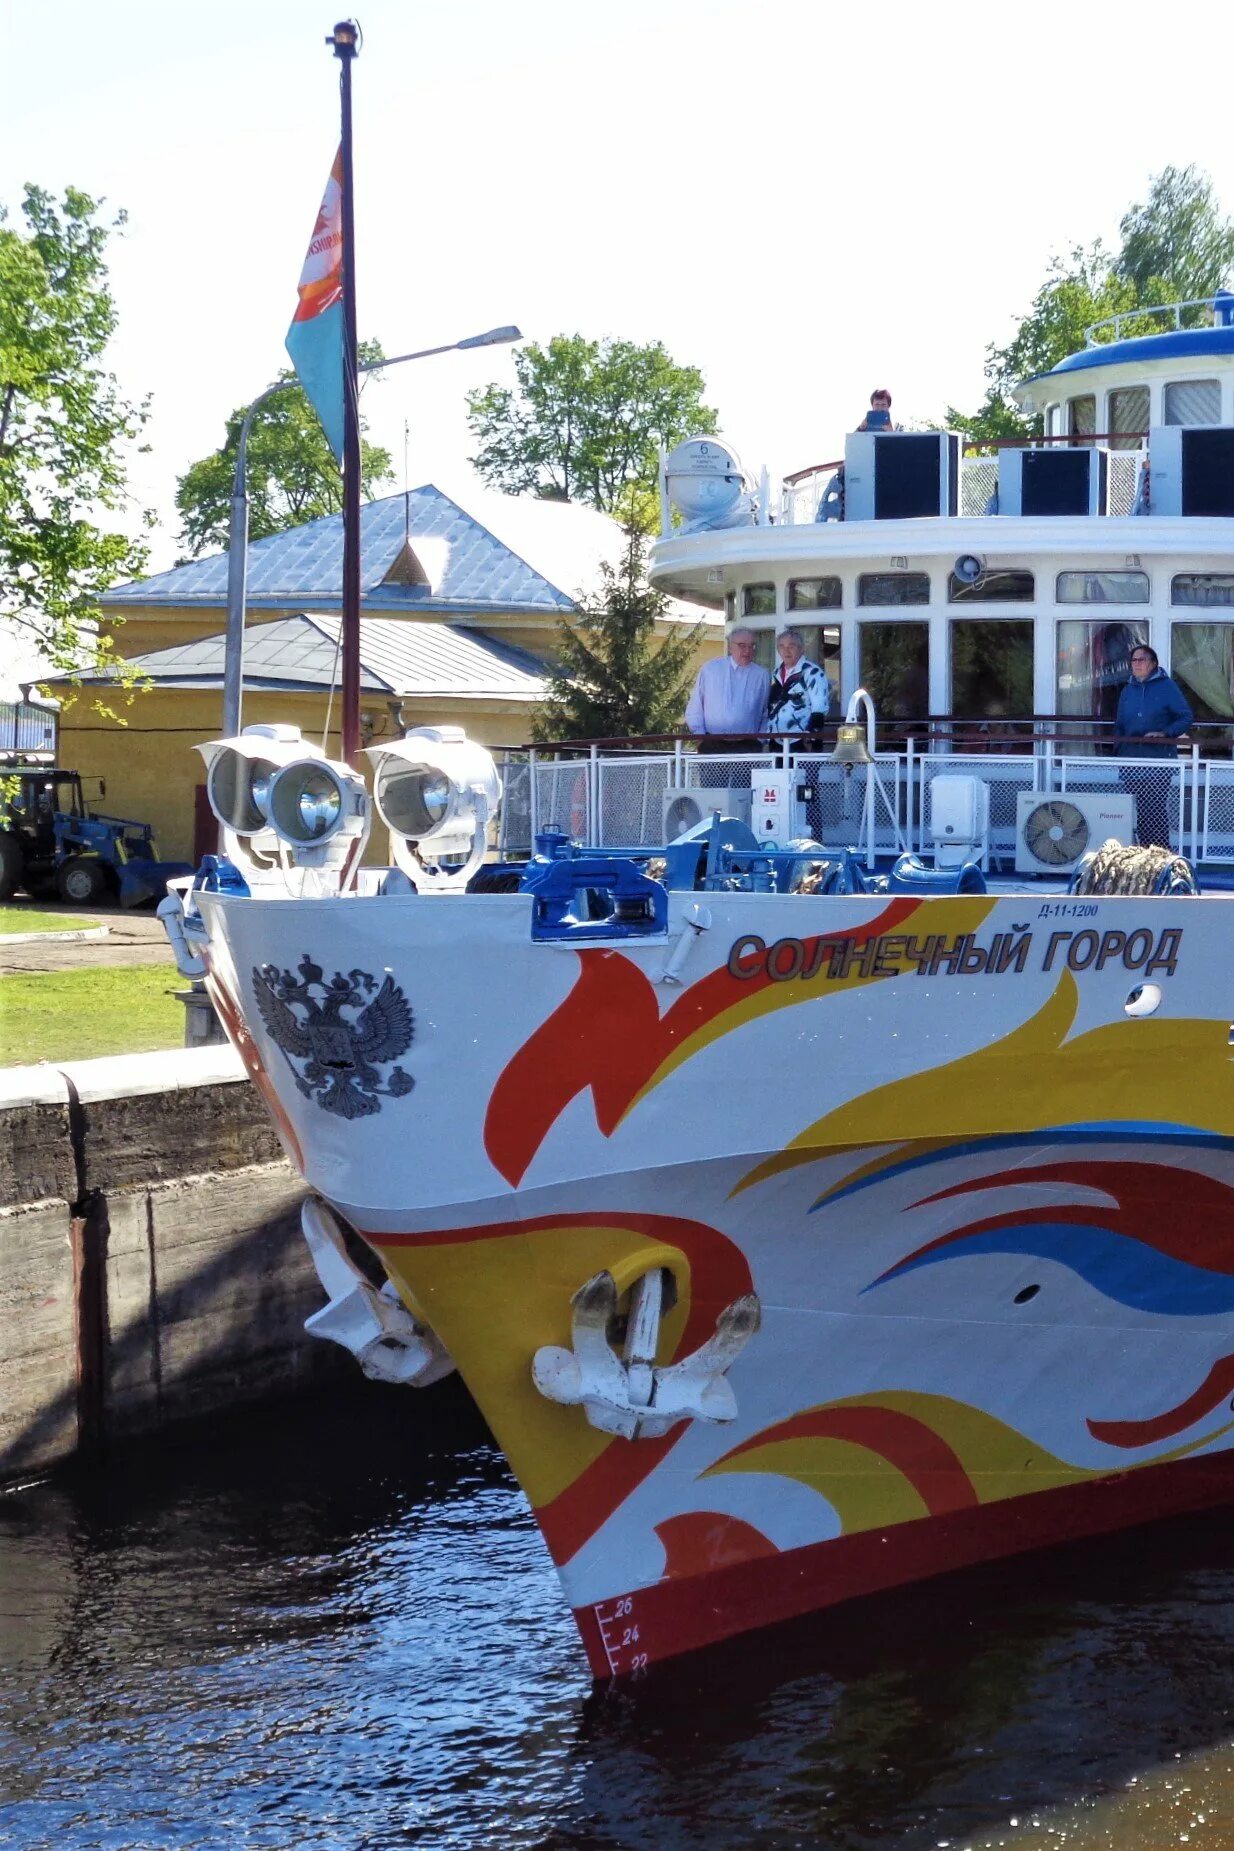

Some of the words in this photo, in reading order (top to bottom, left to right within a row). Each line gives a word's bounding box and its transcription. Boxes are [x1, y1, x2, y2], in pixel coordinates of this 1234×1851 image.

[700, 442, 709, 455] 6
[1037, 904, 1099, 919] Д-11-1200
[727, 923, 1031, 982] СОЛНЕЧНЫЙ
[1041, 928, 1184, 978] ГОРОД
[614, 1597, 633, 1619] 26
[621, 1624, 640, 1646] 24
